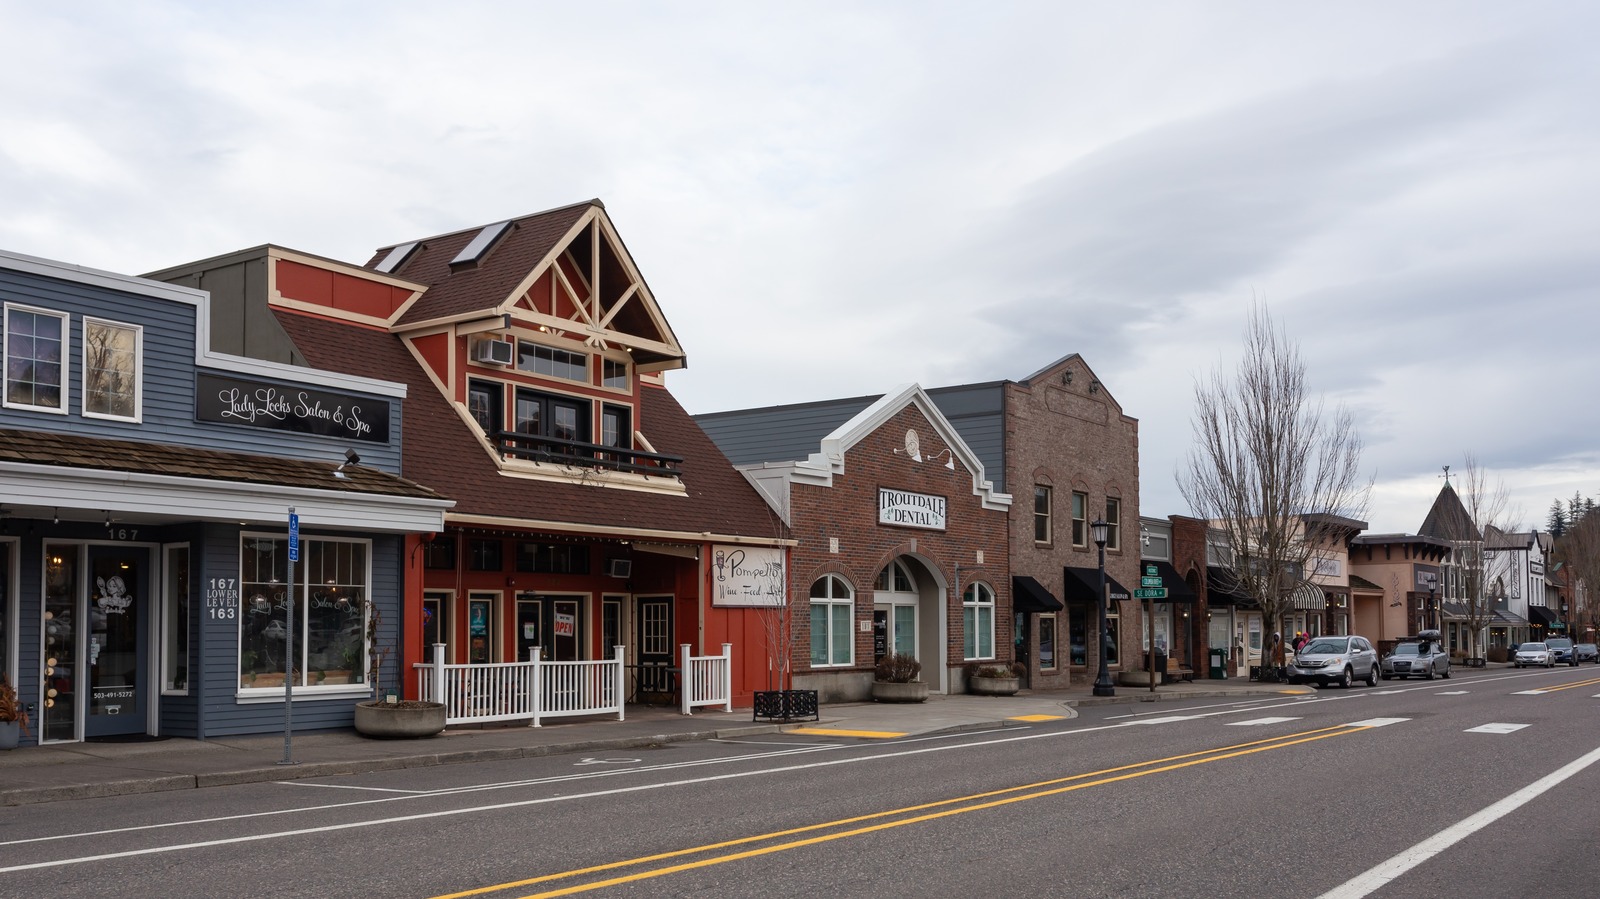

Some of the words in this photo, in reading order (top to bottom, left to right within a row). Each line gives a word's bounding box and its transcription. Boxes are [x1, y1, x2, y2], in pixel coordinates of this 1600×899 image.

[218, 388, 256, 423] Lady
[255, 388, 291, 421] Locks
[294, 391, 331, 420] Salon
[332, 406, 344, 426] &
[346, 406, 372, 438] Spa
[880, 490, 944, 518] TROUTDALE
[894, 508, 932, 526] DENTAL
[108, 528, 138, 541] 167
[725, 549, 779, 580] Pompello
[210, 578, 235, 590] 167
[206, 589, 238, 599] LOWER
[719, 584, 737, 599] Wine
[742, 585, 762, 601] Food
[206, 598, 238, 607] LEVEL
[273, 591, 296, 611] Locs
[209, 608, 235, 619] 163
[555, 620, 574, 634] OPEN
[93, 691, 133, 699] 503-491-5272
